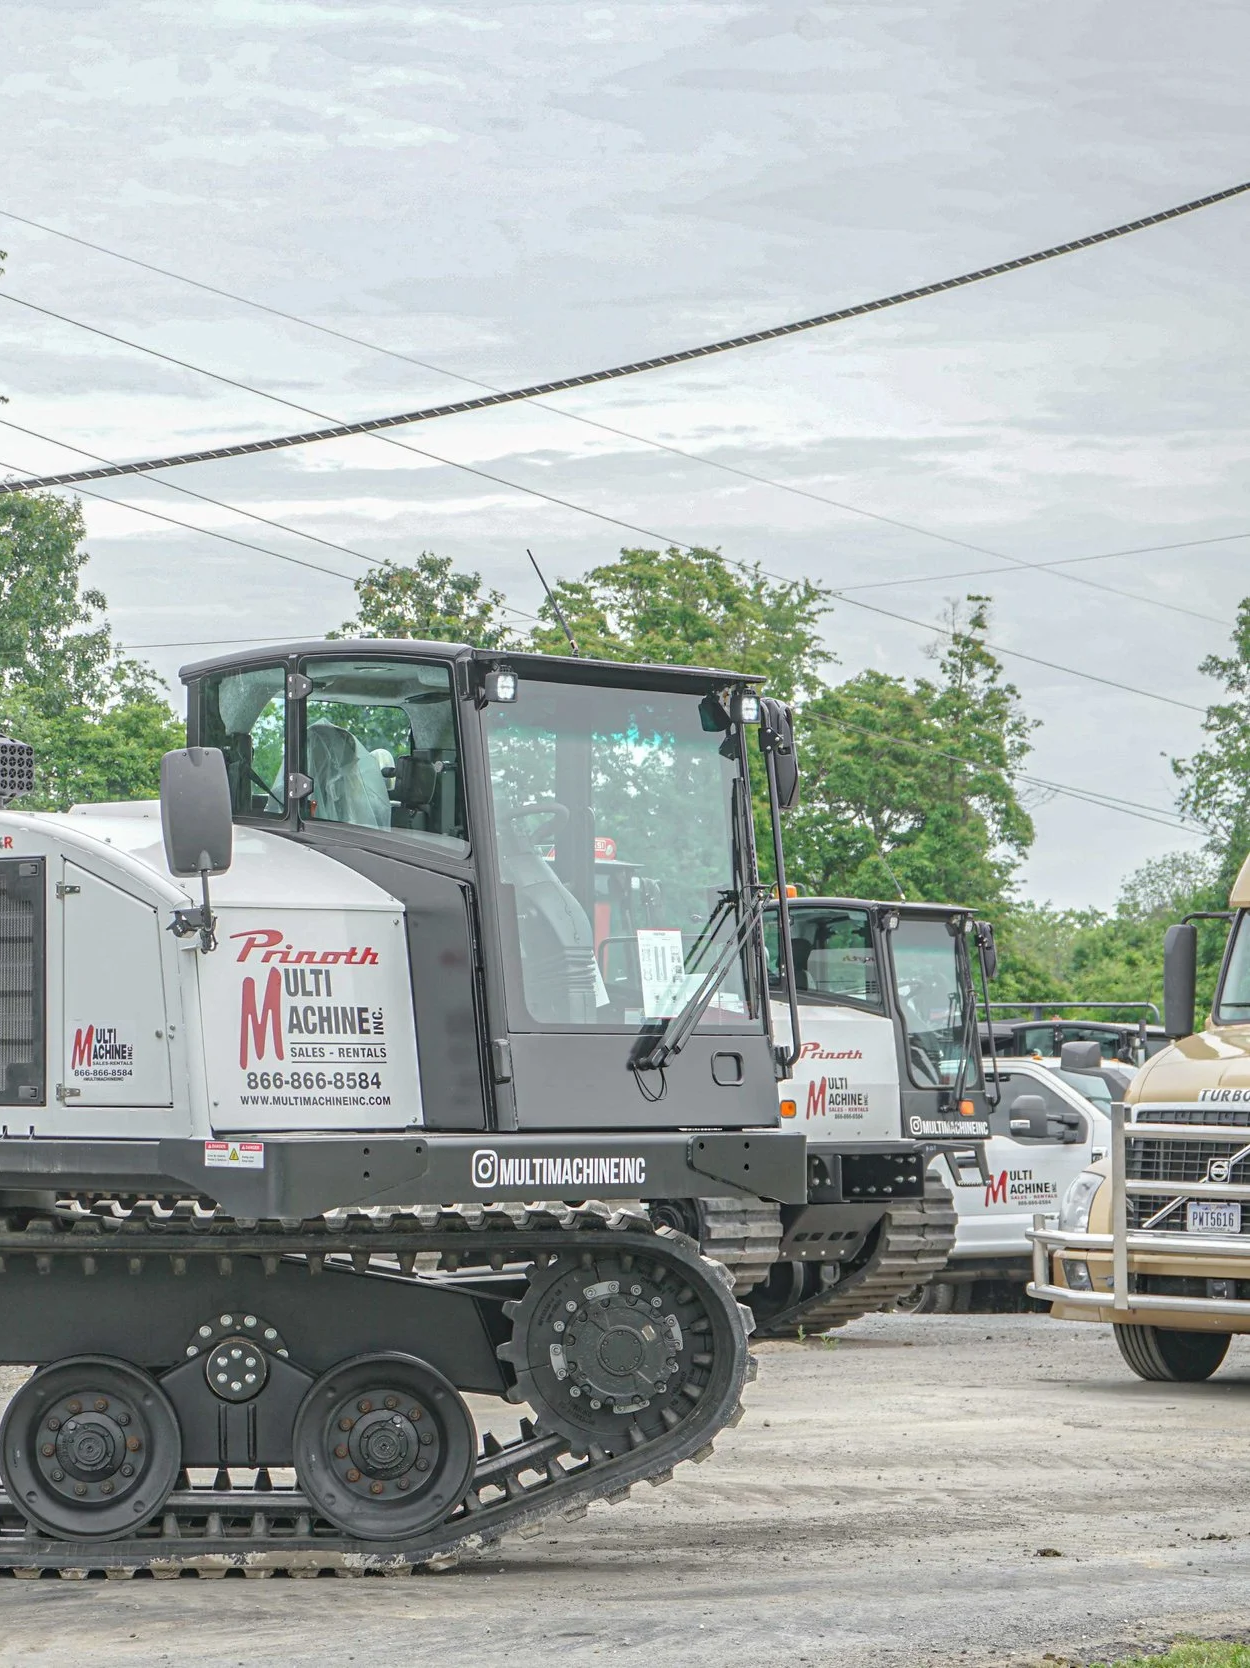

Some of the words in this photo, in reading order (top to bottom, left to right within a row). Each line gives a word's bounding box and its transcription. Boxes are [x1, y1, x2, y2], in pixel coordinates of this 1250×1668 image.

[229, 929, 379, 965] Prinoth
[290, 1047, 326, 1058] SALES
[338, 1047, 387, 1058] RENTALS
[801, 1042, 862, 1059] Prinoth
[74, 1069, 133, 1077] 866-866-8584
[246, 1072, 382, 1090] 866-866-8584
[240, 1095, 391, 1106] WWW.MULTIMACHINEINC.COM
[922, 1121, 989, 1135] MULTIMACHINEINC
[500, 1157, 646, 1185] MULTIMACHINEINC
[1192, 1211, 1234, 1227] PWT5616
